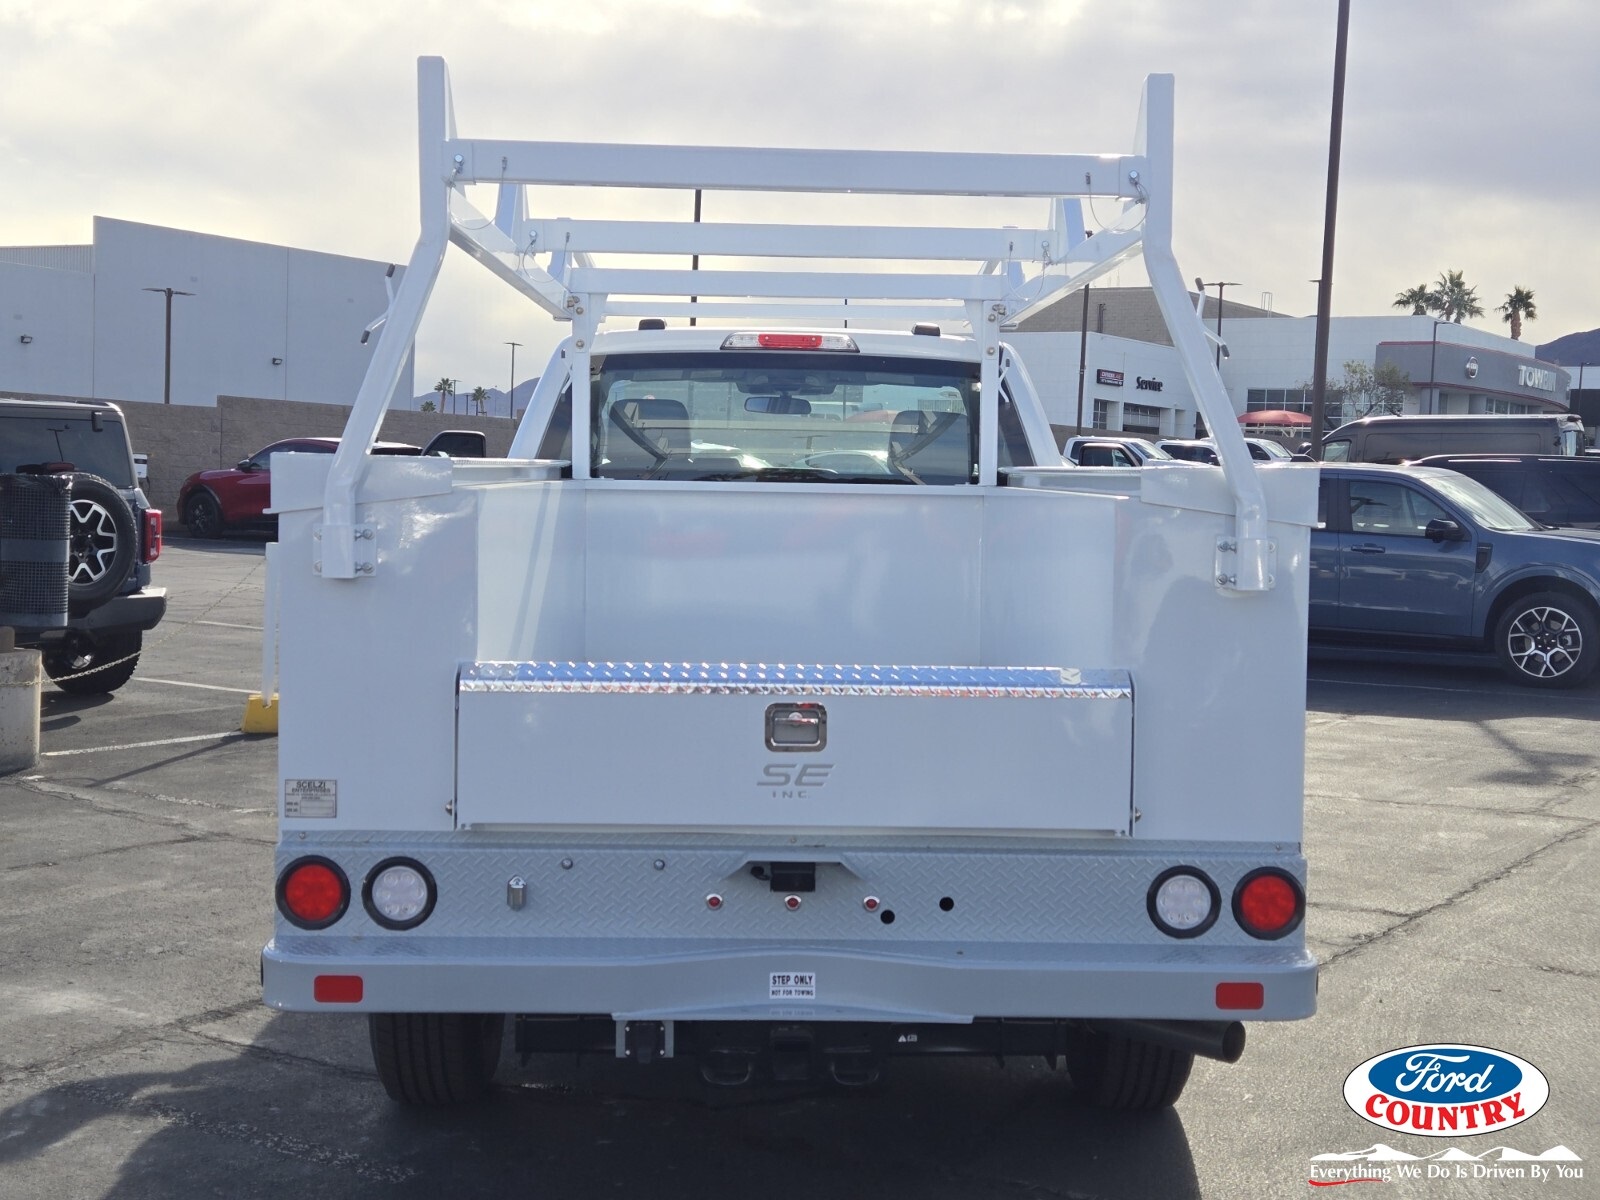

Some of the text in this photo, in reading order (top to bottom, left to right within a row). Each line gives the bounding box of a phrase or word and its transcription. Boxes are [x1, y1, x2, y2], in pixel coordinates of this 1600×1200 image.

[1136, 376, 1163, 392] Service
[757, 764, 835, 786] SE
[296, 781, 326, 789] SCELZI
[772, 975, 813, 985] STEP ONLY
